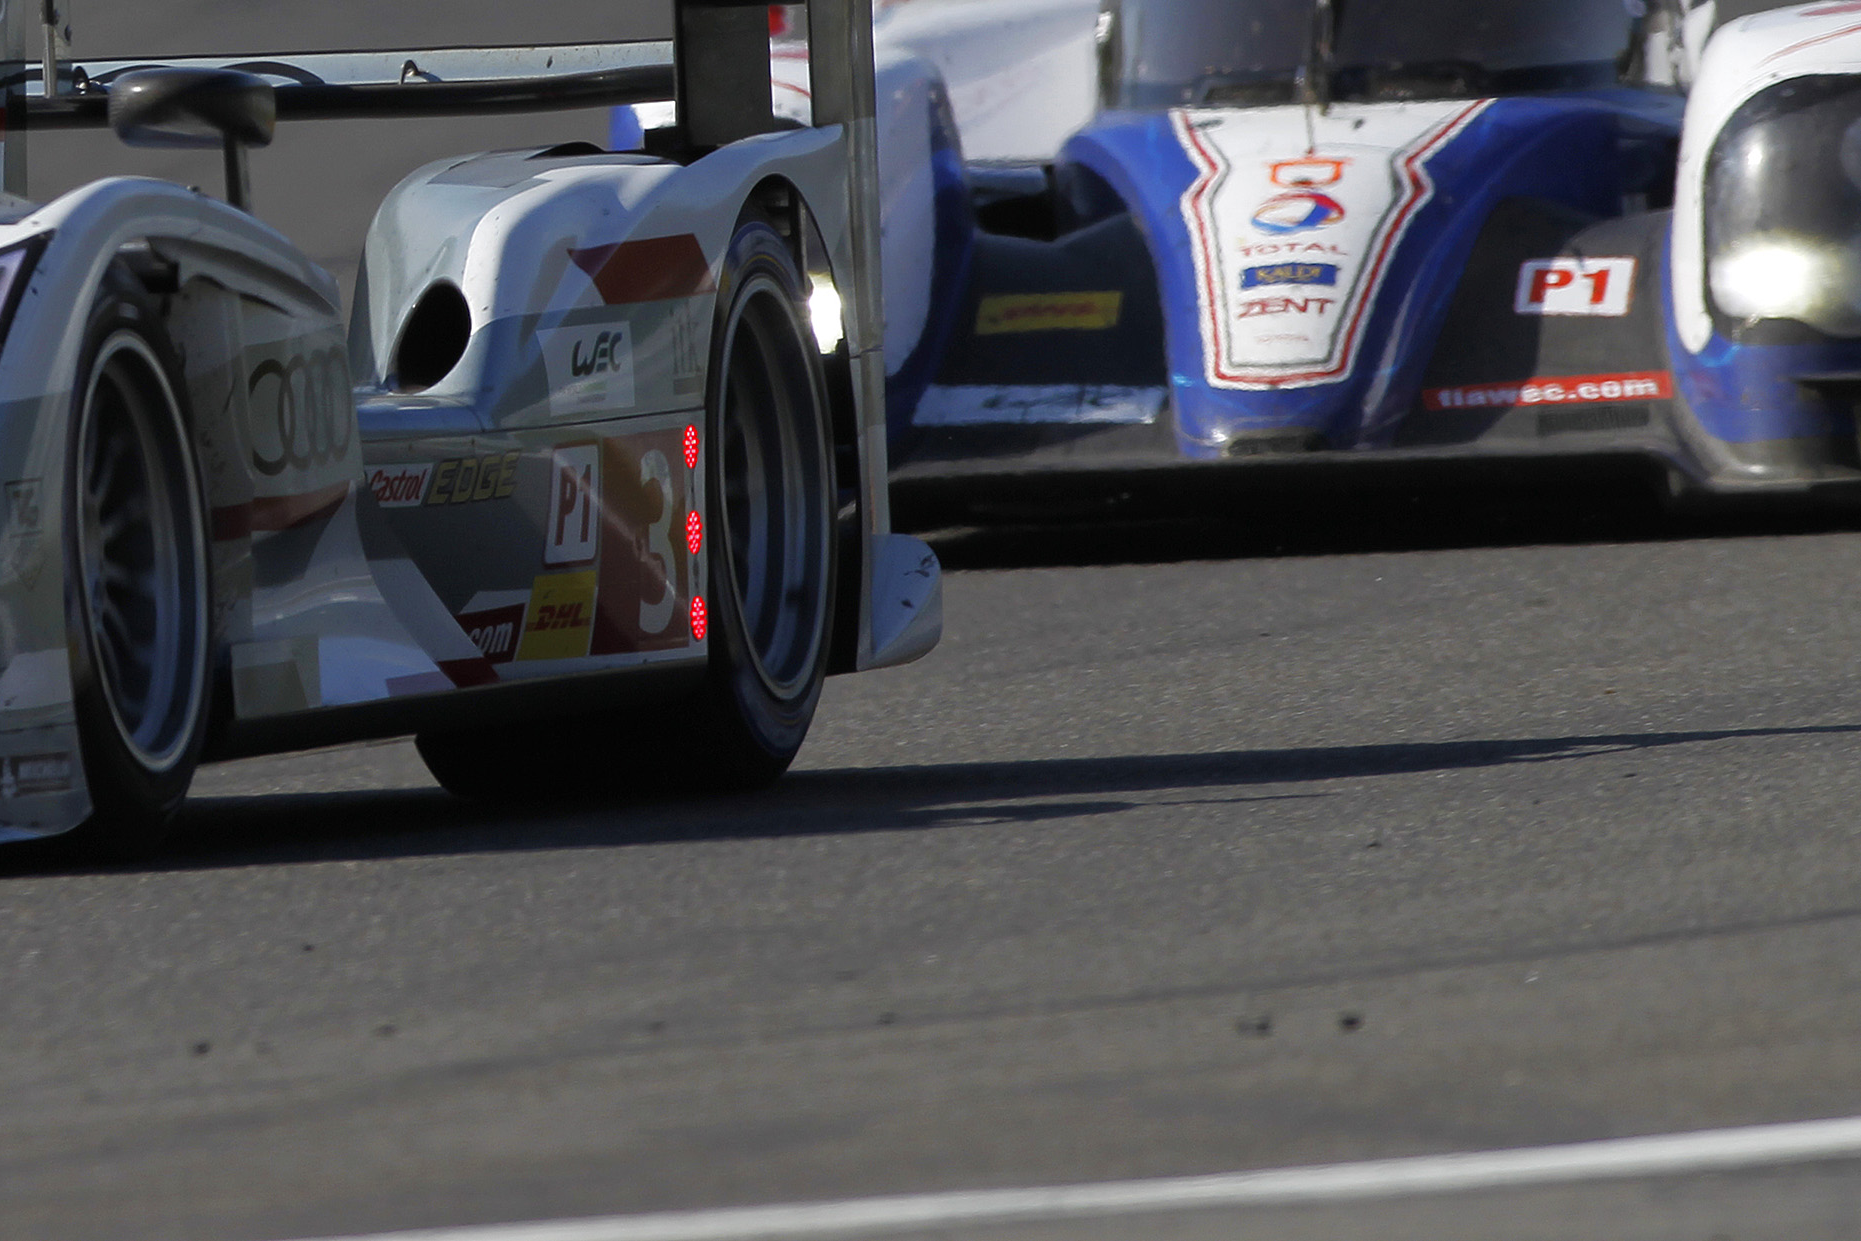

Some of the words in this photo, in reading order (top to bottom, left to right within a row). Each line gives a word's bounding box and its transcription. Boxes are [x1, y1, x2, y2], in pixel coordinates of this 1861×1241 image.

[1239, 241, 1348, 257] TOTAL
[1529, 268, 1610, 305] P1
[1237, 297, 1336, 320] ZENT
[571, 330, 623, 377] WEC
[1438, 378, 1659, 408] fiawec.com
[370, 469, 426, 502] Castrol
[427, 448, 521, 504] EDGE
[553, 463, 591, 546] P1
[638, 449, 677, 634] 3
[534, 602, 584, 631] DHL
